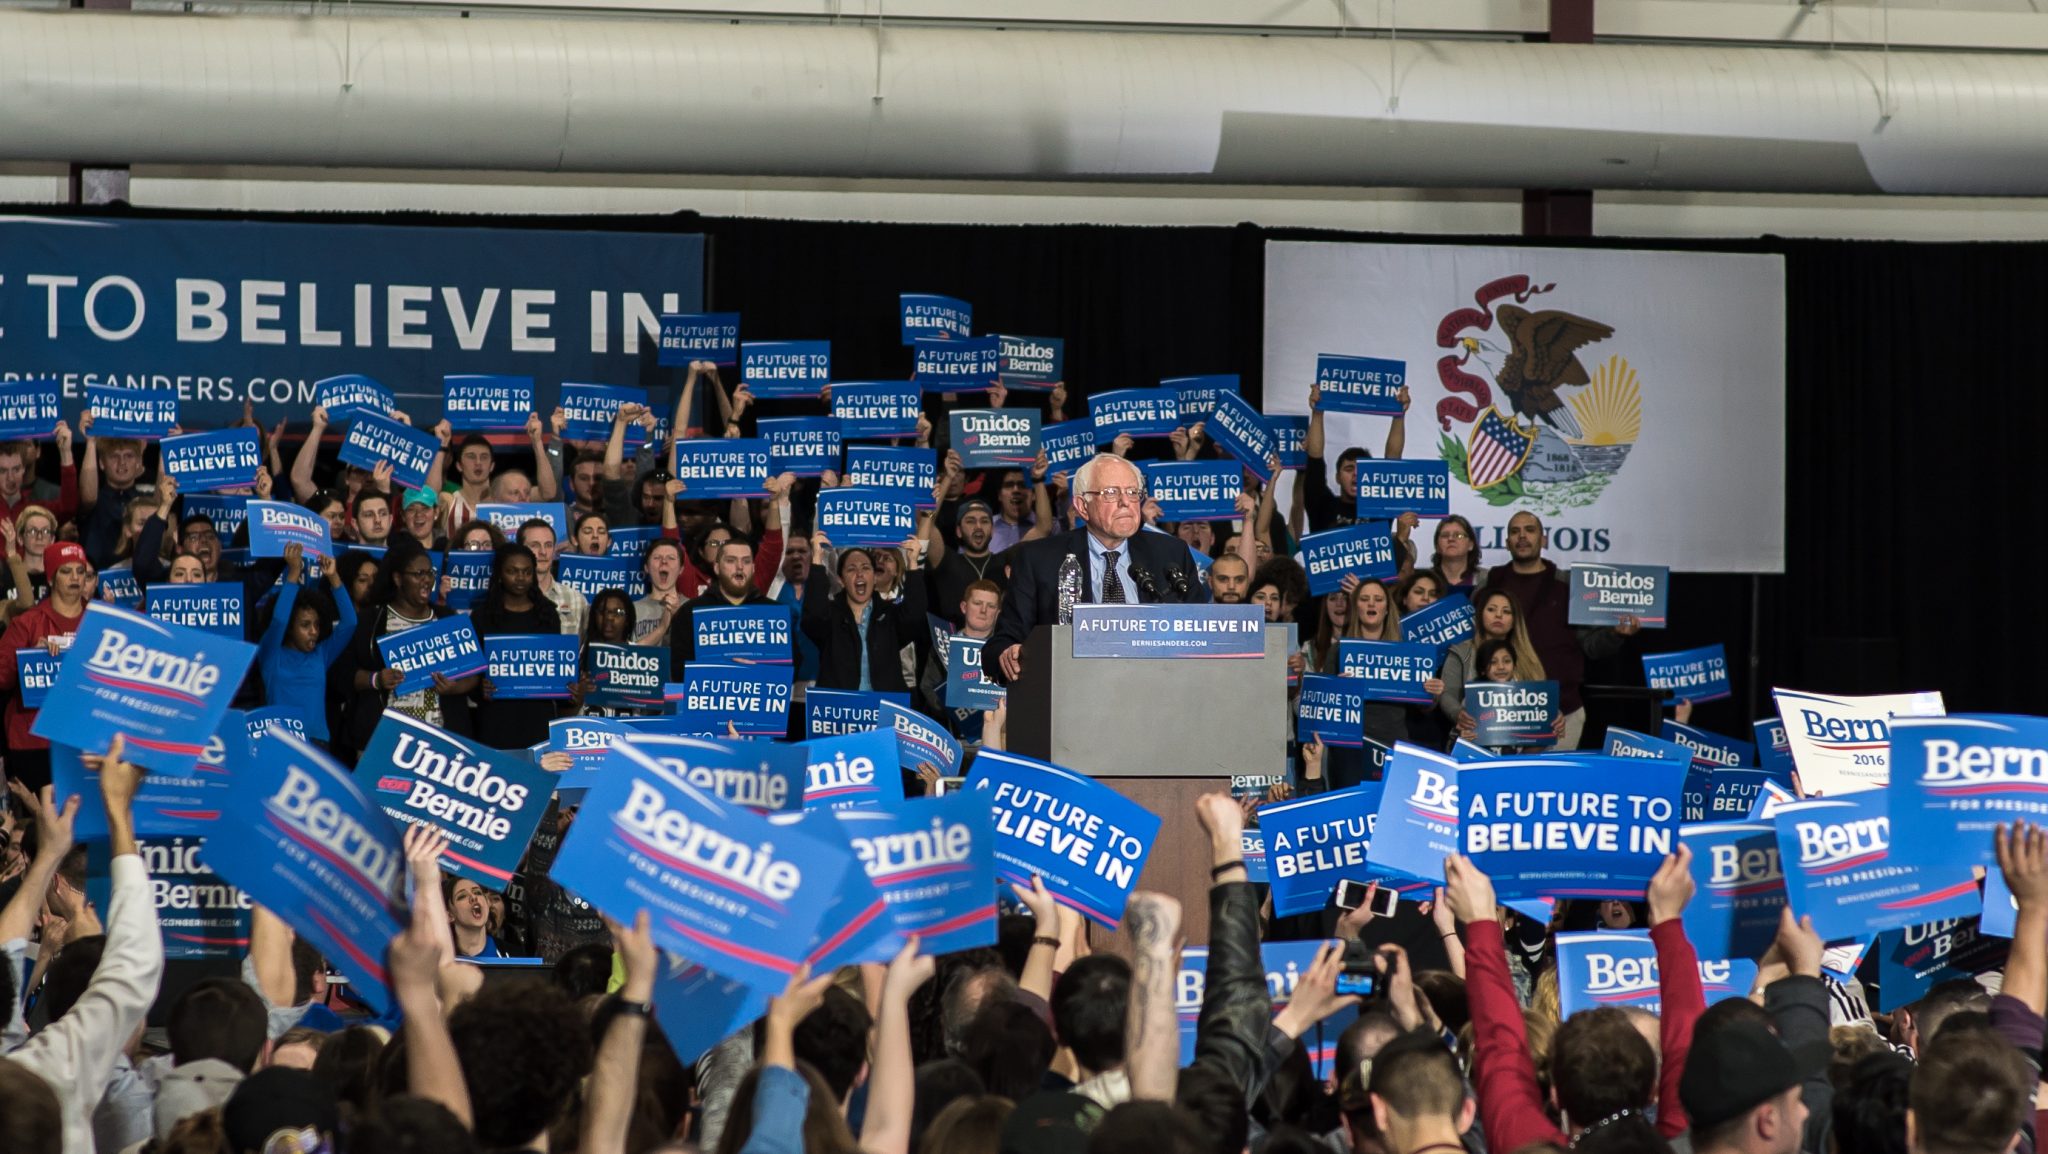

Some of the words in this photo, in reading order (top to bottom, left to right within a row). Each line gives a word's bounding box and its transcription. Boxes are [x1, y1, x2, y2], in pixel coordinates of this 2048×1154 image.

[27, 274, 145, 341] TO
[176, 278, 556, 353] BELIEVE
[591, 290, 679, 354] IN
[906, 305, 913, 315] A
[916, 306, 956, 320] FUTURE
[959, 312, 970, 325] TO
[664, 326, 672, 336] A
[675, 326, 719, 336] FUTURE
[722, 326, 736, 336] TO
[905, 316, 957, 332] BELIEVE
[959, 325, 970, 337] IN
[663, 337, 719, 349] BELIEVE
[722, 337, 736, 349] IN
[998, 342, 1054, 359] Unidos
[1009, 358, 1053, 373] Bernie
[1321, 368, 1329, 378] A
[1333, 368, 1382, 382] FUTURE
[1385, 374, 1402, 385] TO
[449, 388, 457, 398] A
[460, 387, 508, 399] FUTURE
[513, 389, 530, 399] TO
[1320, 379, 1384, 395] BELIEVE
[1385, 384, 1402, 397] IN
[92, 395, 100, 405] A
[103, 396, 153, 411] FUTURE
[157, 400, 175, 410] TO
[448, 400, 510, 412] BELIEVE
[514, 401, 530, 412] IN
[1095, 405, 1102, 414] A
[1105, 400, 1154, 413] FUTURE
[1157, 399, 1175, 410] TO
[91, 406, 153, 422] BELIEVE
[158, 411, 175, 422] IN
[1095, 410, 1157, 427] BELIEVE
[1160, 409, 1177, 420] IN
[962, 415, 1030, 433] Unidos
[979, 432, 1030, 447] Bernie
[168, 449, 177, 460] A
[180, 443, 233, 458] FUTURE
[237, 441, 256, 453] TO
[681, 453, 690, 464] A
[693, 453, 745, 464] FUTURE
[749, 453, 767, 464] TO
[169, 454, 236, 473] BELIEVE
[241, 453, 259, 467] IN
[680, 465, 746, 478] BELIEVE
[750, 465, 767, 478] IN
[1361, 473, 1370, 483] A
[1374, 473, 1424, 484] FUTURE
[1428, 475, 1445, 485] TO
[1154, 476, 1163, 486] A
[1166, 475, 1217, 486] FUTURE
[1222, 474, 1239, 485] TO
[1154, 488, 1219, 501] BELIEVE
[1223, 487, 1240, 499] IN
[1361, 486, 1425, 499] BELIEVE
[1429, 487, 1445, 499] IN
[824, 502, 832, 512] A
[836, 501, 889, 513] FUTURE
[893, 503, 912, 515] TO
[262, 508, 323, 537] Bernie
[823, 513, 890, 527] BELIEVE
[895, 514, 912, 527] IN
[1308, 549, 1316, 560] A
[1320, 541, 1371, 557] FUTURE
[1372, 536, 1389, 548] TO
[1310, 552, 1374, 575] BELIEVE
[1376, 549, 1392, 562] IN
[1583, 571, 1654, 590] Unidos
[1599, 590, 1654, 605] Bernie
[698, 622, 707, 632] A
[711, 619, 764, 632] FUTURE
[768, 619, 787, 630] TO
[1079, 619, 1089, 631] A
[1092, 619, 1147, 632] FUTURE
[1150, 620, 1170, 632] TO
[1173, 620, 1238, 632] BELIEVE
[1242, 620, 1259, 632] IN
[698, 632, 766, 646] BELIEVE
[770, 632, 788, 644] IN
[1131, 639, 1208, 647] BERNIESANDERS.COM
[88, 628, 220, 697] Bernie
[596, 651, 659, 671] Unidos
[1345, 653, 1354, 664] A
[1357, 653, 1410, 667] FUTURE
[1415, 657, 1433, 669] TO
[1650, 666, 1657, 677] A
[1658, 661, 1704, 676] FUTURE
[1707, 658, 1723, 669] TO
[609, 670, 659, 687] Bernie
[1344, 666, 1411, 682] BELIEVE
[1416, 668, 1433, 682] IN
[1650, 673, 1707, 688] BELIEVE
[1710, 669, 1726, 681] IN
[689, 680, 698, 692] A
[702, 680, 760, 695] FUTURE
[766, 684, 787, 696] TO
[687, 696, 760, 712] BELIEVE
[765, 698, 785, 713] IN
[1478, 688, 1548, 708] Unidos
[1496, 707, 1548, 722] Bernie
[1800, 708, 1895, 741] Bern
[894, 713, 955, 764] Bernie
[1852, 754, 1885, 766] 2016
[392, 732, 529, 812] Unidos
[1716, 783, 1726, 795] A
[1684, 792, 1703, 804] TO
[1950, 799, 1981, 811] FOR
[405, 780, 511, 841] Bernie
[1468, 793, 1488, 819] A
[1496, 792, 1618, 819] FUTURE
[1626, 795, 1672, 822] TO
[1686, 807, 1704, 820] IN
[994, 782, 1103, 839] FUTURE
[1108, 825, 1143, 860] TO
[1427, 822, 1451, 834] FOR
[614, 777, 801, 901] Bernie
[1274, 831, 1291, 851] A
[1467, 823, 1618, 853] BELIEVE
[1625, 825, 1670, 855] IN
[992, 806, 1094, 867] LIEVE
[1094, 851, 1134, 890] IN
[1275, 841, 1371, 878] BELIE
[1825, 872, 1850, 887] FOR
